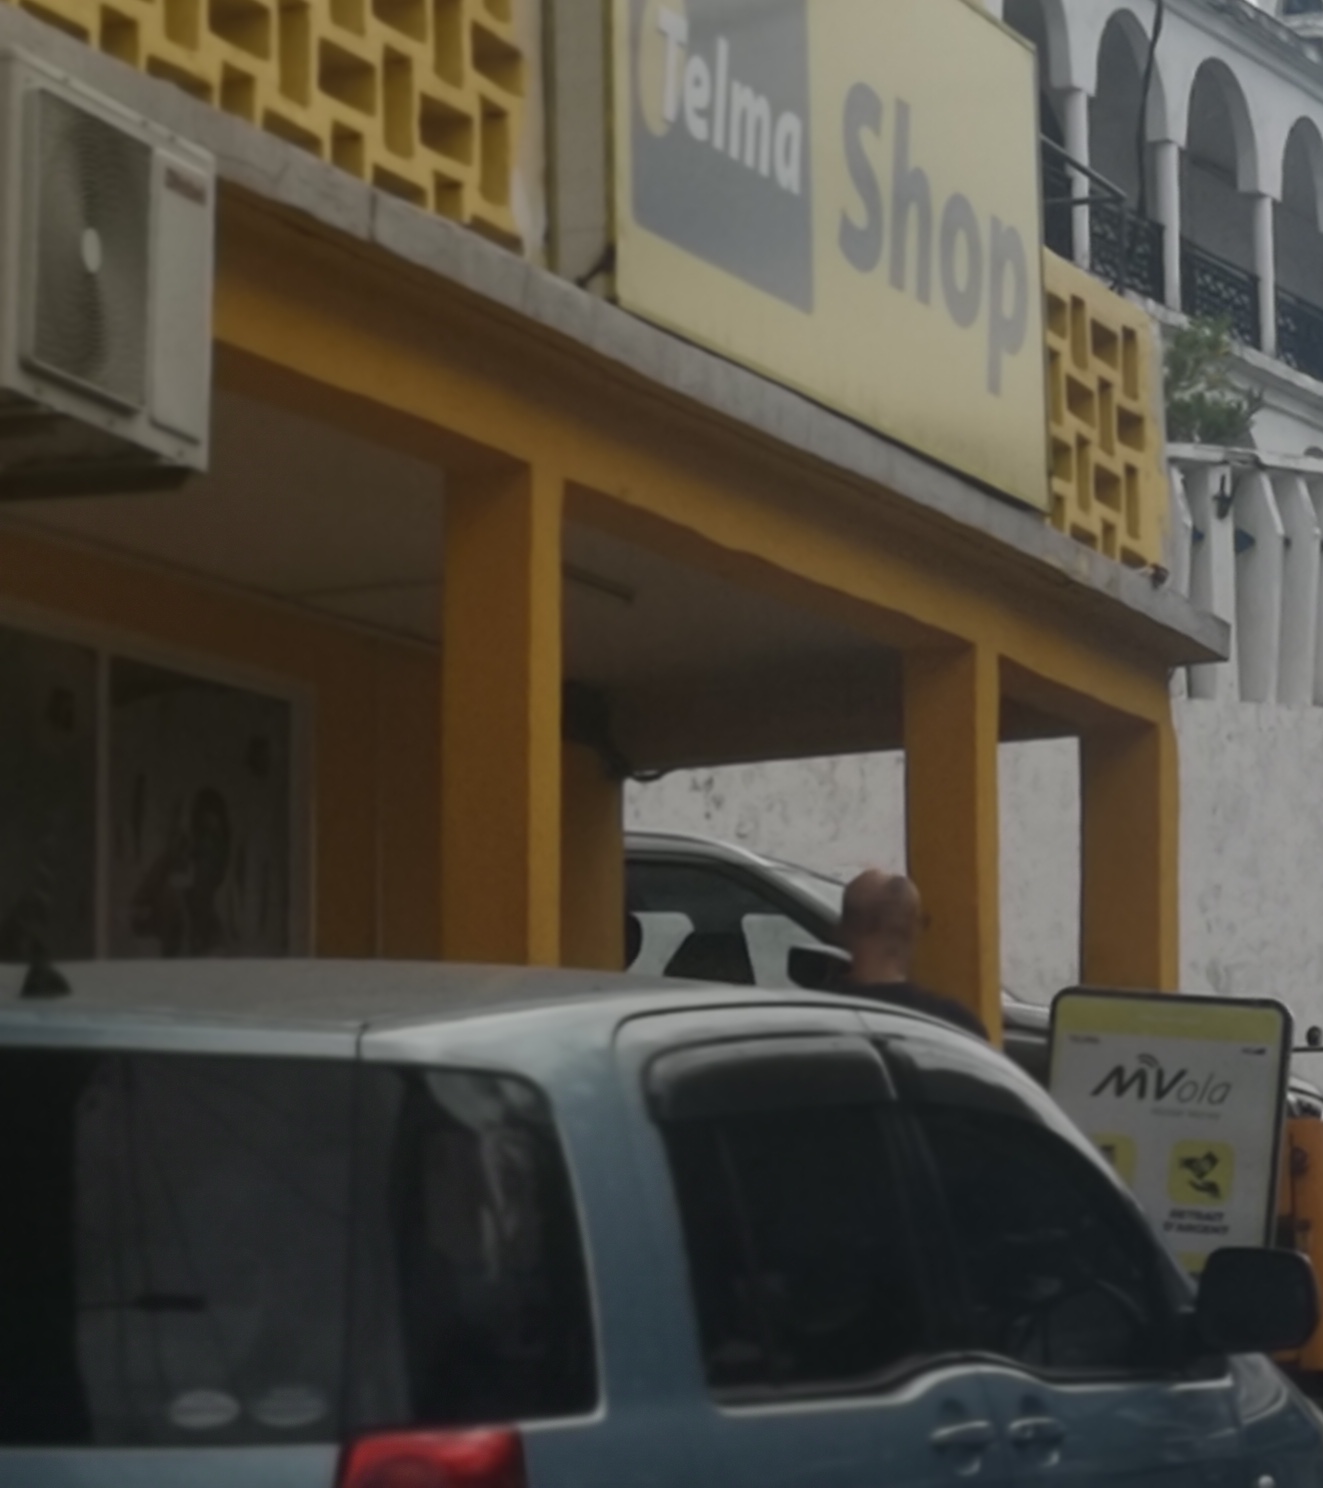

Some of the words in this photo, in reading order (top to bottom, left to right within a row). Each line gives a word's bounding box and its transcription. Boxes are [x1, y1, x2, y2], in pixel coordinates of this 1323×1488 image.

[655, 8, 801, 196] Telma
[838, 82, 1029, 398] Shop
[1090, 1064, 1232, 1106] MVola
